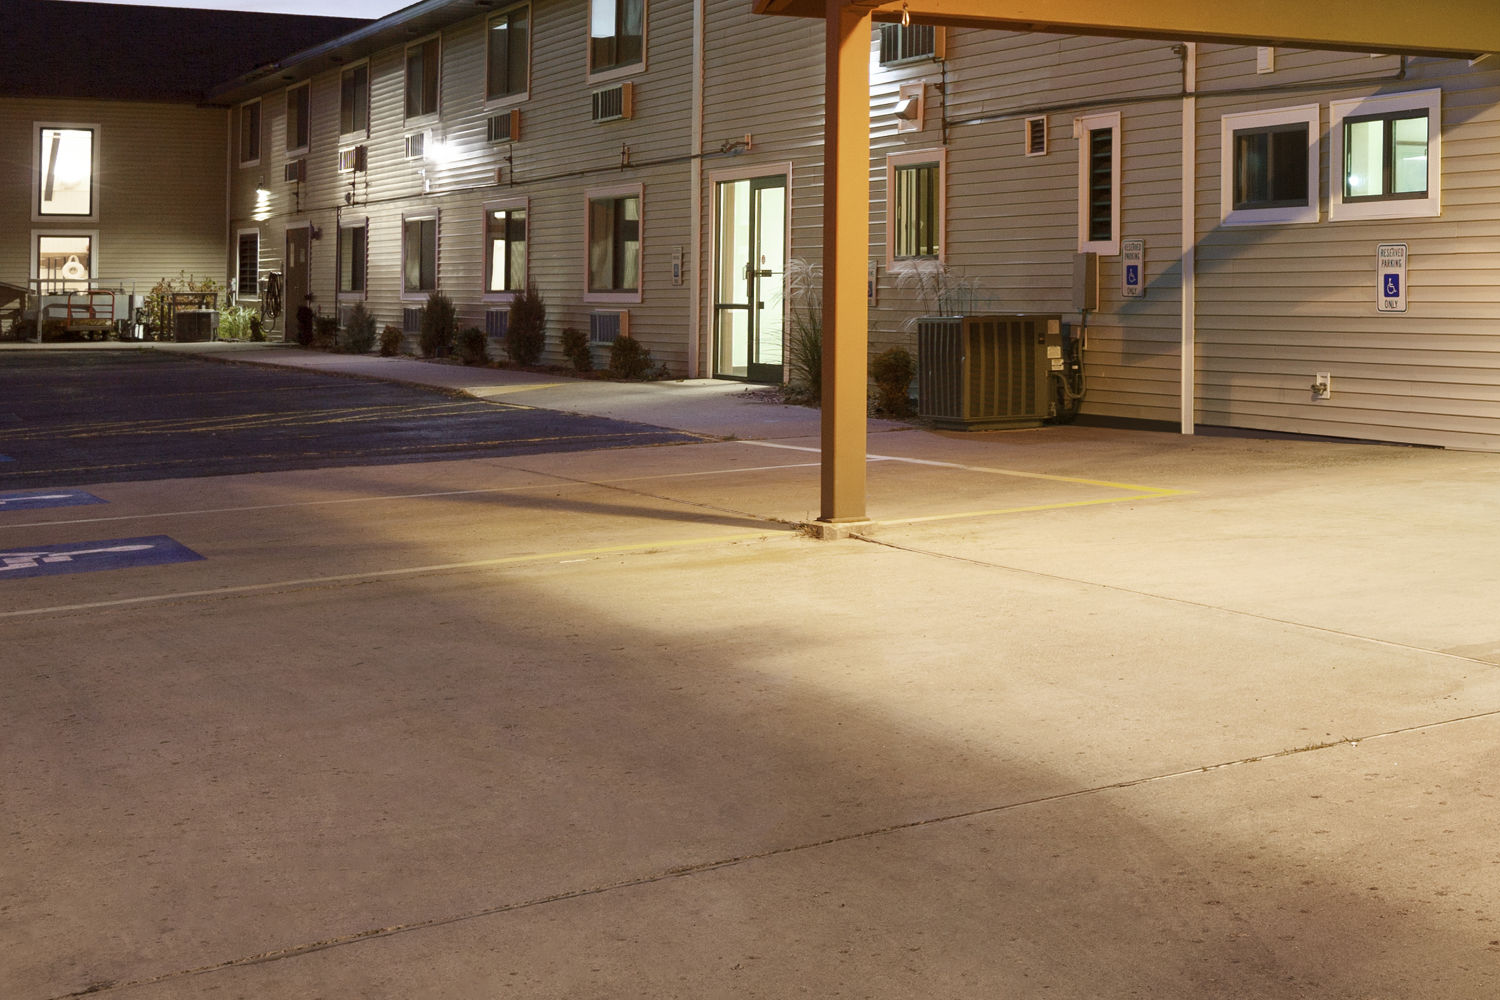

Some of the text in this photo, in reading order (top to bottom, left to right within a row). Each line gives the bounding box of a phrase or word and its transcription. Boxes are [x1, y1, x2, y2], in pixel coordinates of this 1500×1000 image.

[1380, 247, 1404, 258] RESERVED
[1381, 259, 1402, 268] PARKING
[1384, 299, 1398, 309] ONLY
